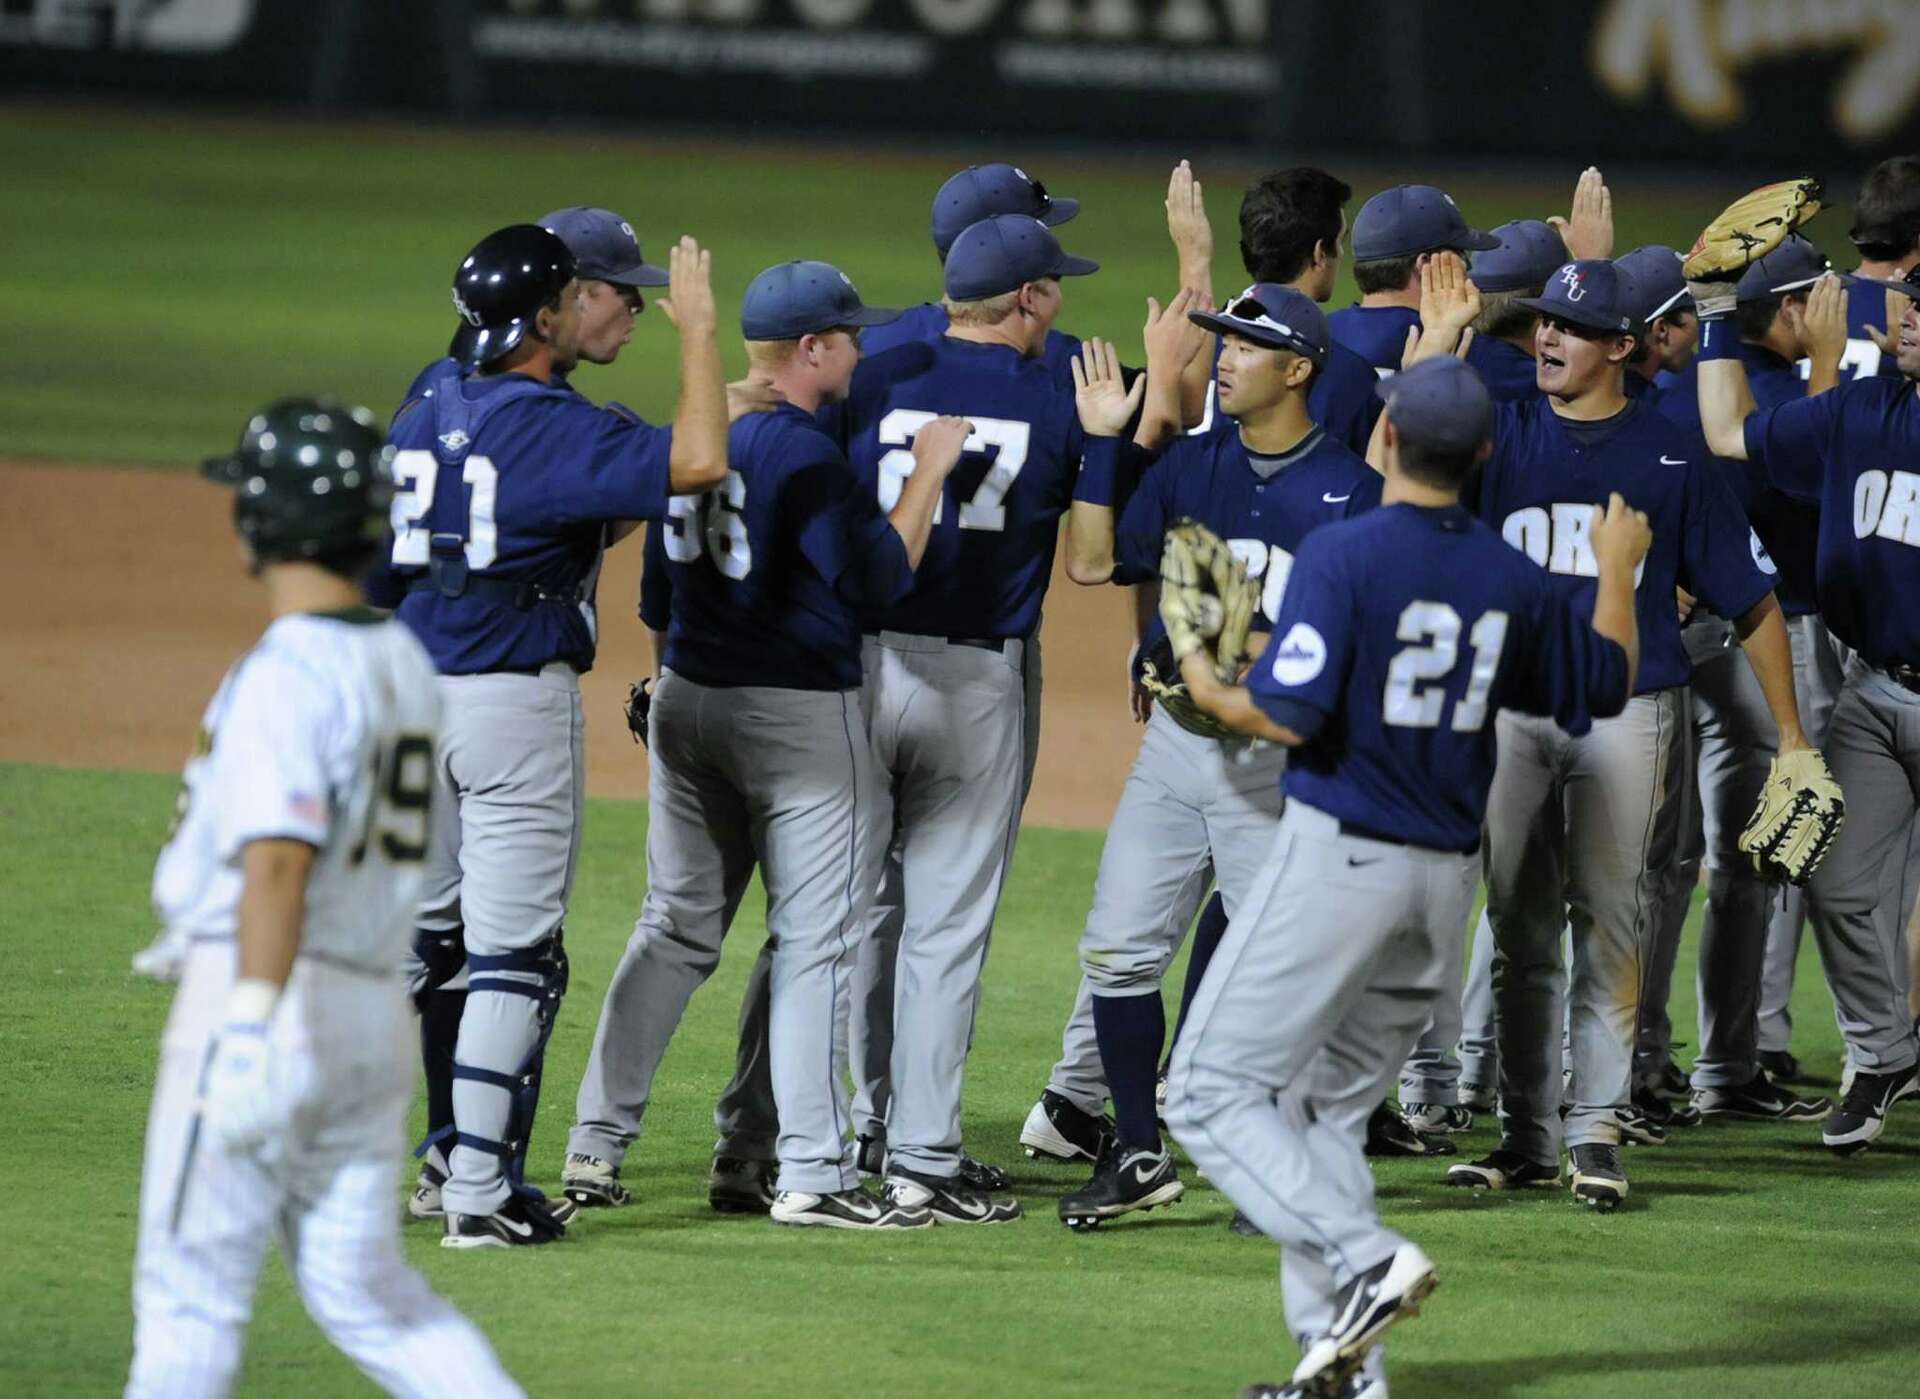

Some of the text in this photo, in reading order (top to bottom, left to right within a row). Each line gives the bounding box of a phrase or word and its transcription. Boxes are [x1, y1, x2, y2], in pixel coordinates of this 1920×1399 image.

[1560, 264, 1587, 301] ORU
[390, 449, 498, 570] 21
[878, 408, 1031, 532] 27
[1502, 503, 1645, 590] OR
[1383, 600, 1509, 732] 21
